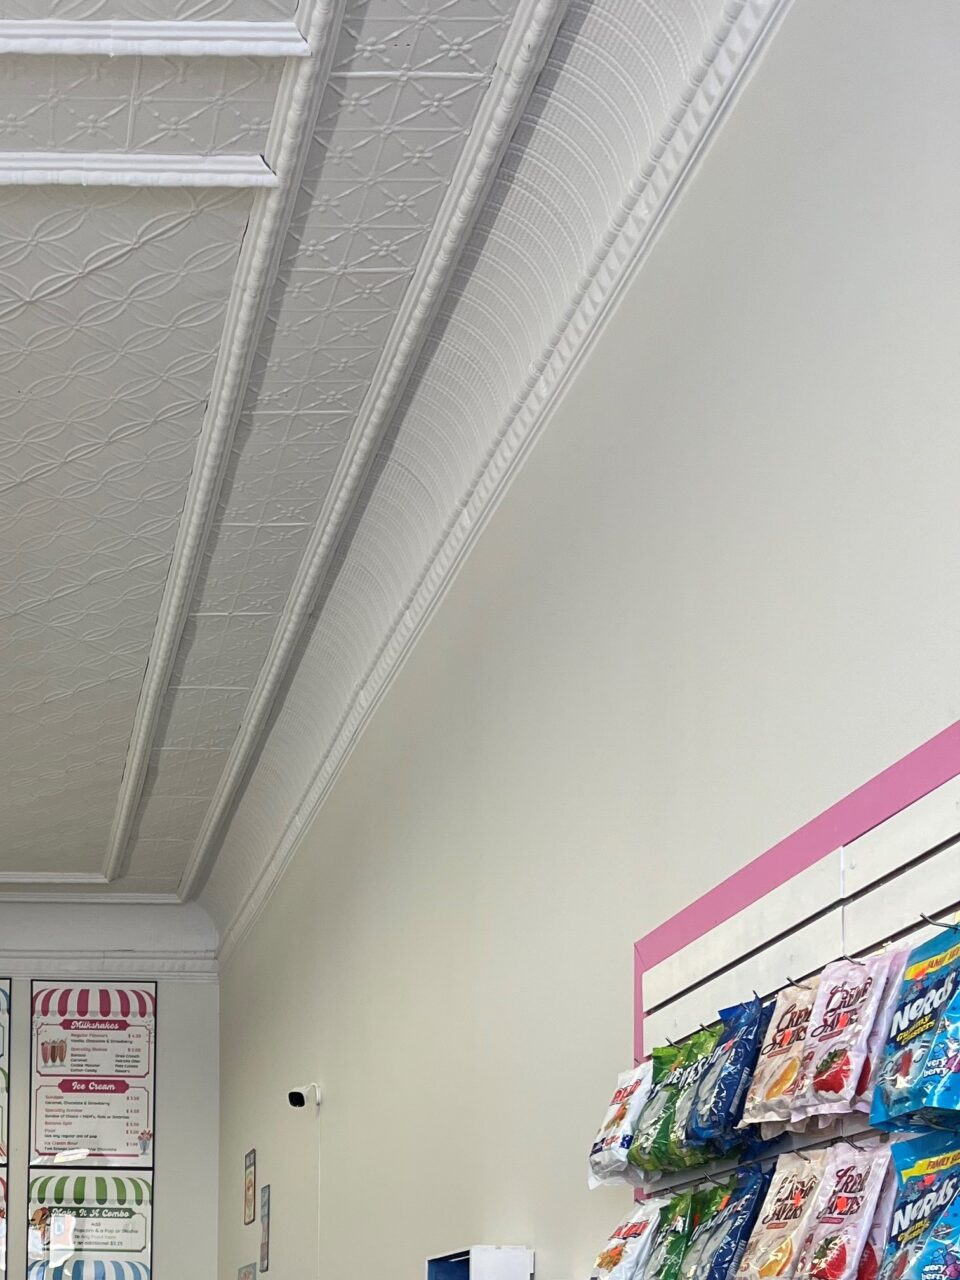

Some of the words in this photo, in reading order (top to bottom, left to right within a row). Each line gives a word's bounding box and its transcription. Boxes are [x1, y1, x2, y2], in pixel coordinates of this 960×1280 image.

[70, 1020, 120, 1030] Milkshakes
[71, 1081, 86, 1090] Ice
[88, 1081, 116, 1091] Cream
[101, 1208, 130, 1218] Combo
